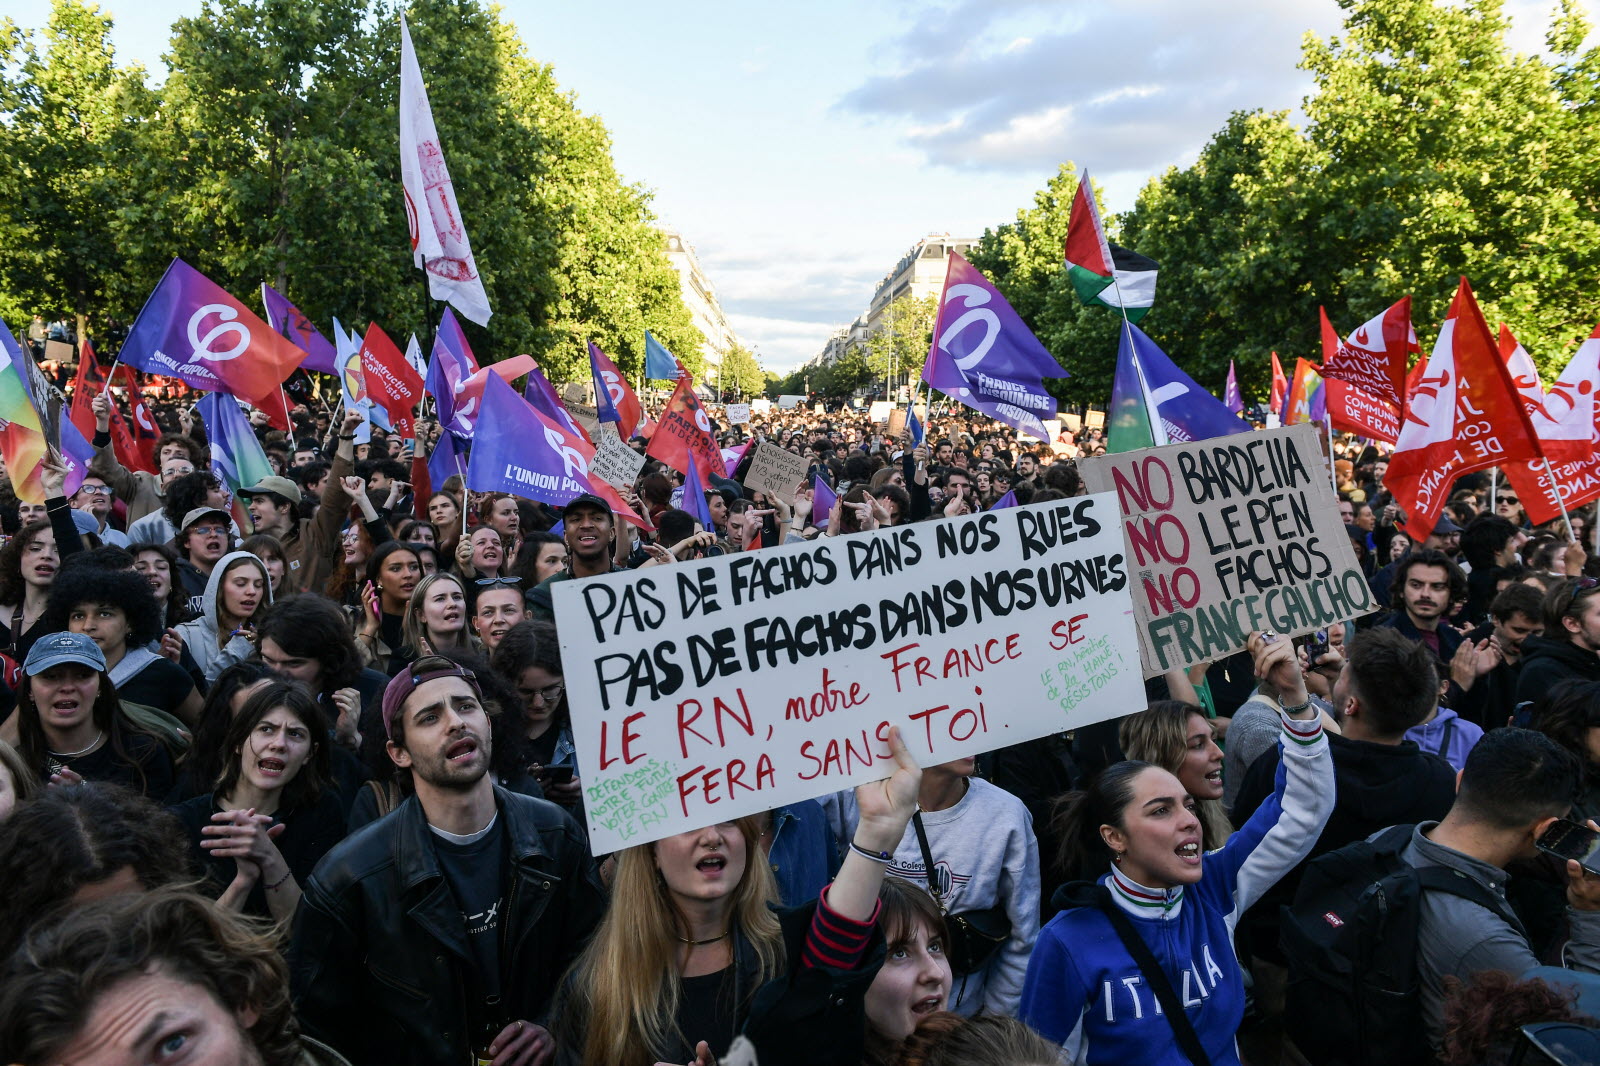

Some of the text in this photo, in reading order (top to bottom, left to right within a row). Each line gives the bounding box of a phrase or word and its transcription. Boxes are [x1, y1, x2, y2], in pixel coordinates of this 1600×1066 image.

[978, 373, 1027, 393] FRANCE
[979, 387, 1050, 411] INSOUMISE
[668, 411, 701, 440] PARTI
[1345, 405, 1362, 421] DE
[505, 464, 560, 491] L'UNION
[1112, 455, 1174, 515] NO
[1126, 513, 1190, 567] NO
[582, 500, 1101, 643] PAS DE FACHOS DANS NOS RUES
[1144, 537, 1332, 616] NO FACHOS
[594, 553, 1127, 711] PAS DE FACHOS DANS NOS URNES
[1148, 594, 1260, 671] FRANCE
[1265, 569, 1370, 634] GAUCHO
[600, 711, 648, 770] LE
[785, 667, 870, 723] notre
[880, 633, 1022, 692] FRANCE
[1049, 614, 1089, 650] SE
[1040, 668, 1053, 686] LE
[586, 758, 660, 802] DÉFENDONS
[675, 753, 776, 818] FERA
[798, 720, 893, 780] SANS
[590, 788, 632, 821] NOTRE
[600, 800, 641, 831] VOTER
[618, 820, 638, 841] LE
[1104, 945, 1224, 1021] ITLIA
